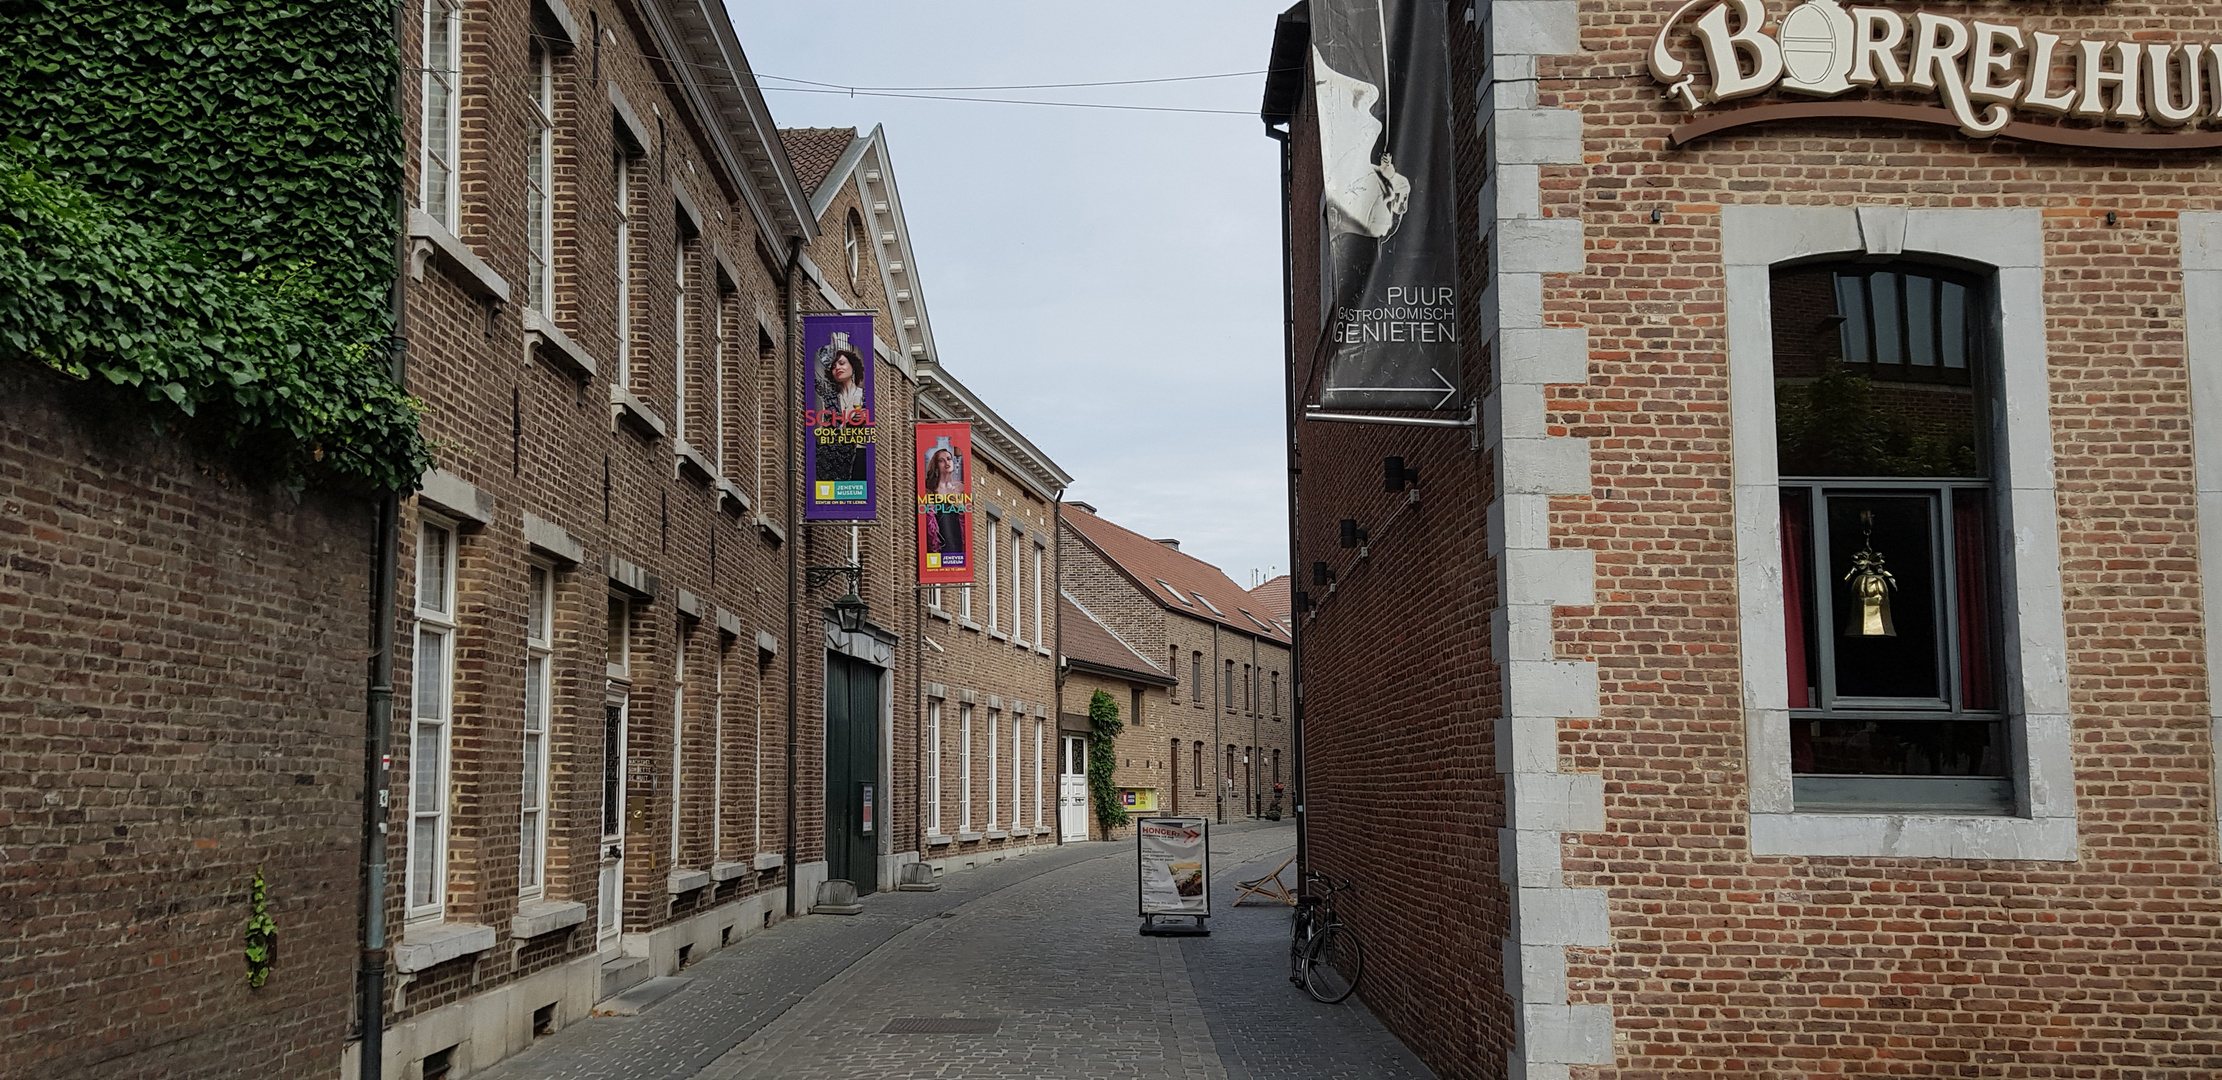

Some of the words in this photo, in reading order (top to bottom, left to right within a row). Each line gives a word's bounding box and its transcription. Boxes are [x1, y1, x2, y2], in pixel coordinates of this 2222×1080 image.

[1387, 286, 1454, 306] PUUR
[1338, 306, 1455, 322] GASTRONOMISCH
[1333, 321, 1456, 344] GENIETEN
[805, 409, 876, 427] SCHOL
[813, 427, 837, 437] OOK
[840, 427, 876, 436] LEKKER
[820, 435, 835, 444] BIJ
[838, 435, 877, 444] PLADIJS
[917, 493, 973, 504] MEDICIJN
[935, 503, 973, 514] PLAAG
